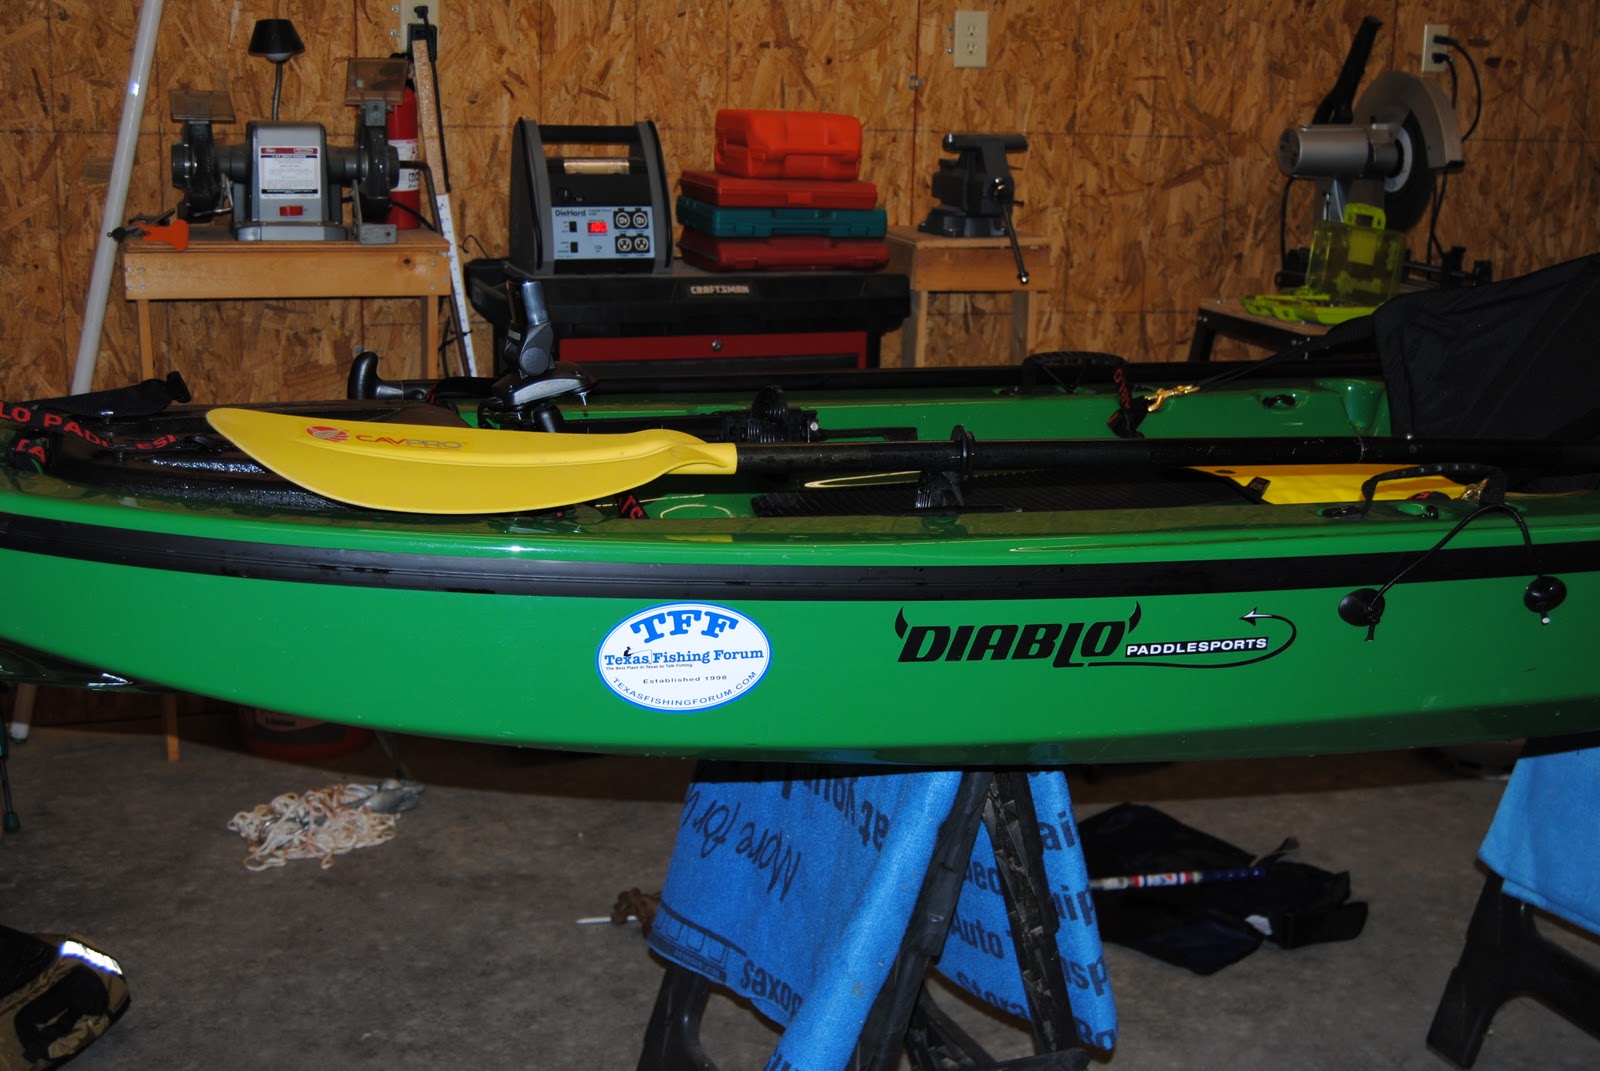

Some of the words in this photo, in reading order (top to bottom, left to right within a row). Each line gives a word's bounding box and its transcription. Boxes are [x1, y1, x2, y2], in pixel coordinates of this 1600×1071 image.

[555, 209, 586, 217] DieHard
[690, 285, 750, 295] CRAFTSMAN
[356, 434, 463, 449] CAVPRO
[630, 609, 739, 643] TFF
[897, 620, 1126, 668] DIABLO
[1126, 638, 1267, 656] PADDLESPORTS
[604, 654, 650, 666] Texas
[652, 650, 711, 664] Fishing
[713, 649, 764, 661] Forum
[613, 671, 757, 706] TEXASFISHINGFORUM.COM
[735, 823, 802, 902] More
